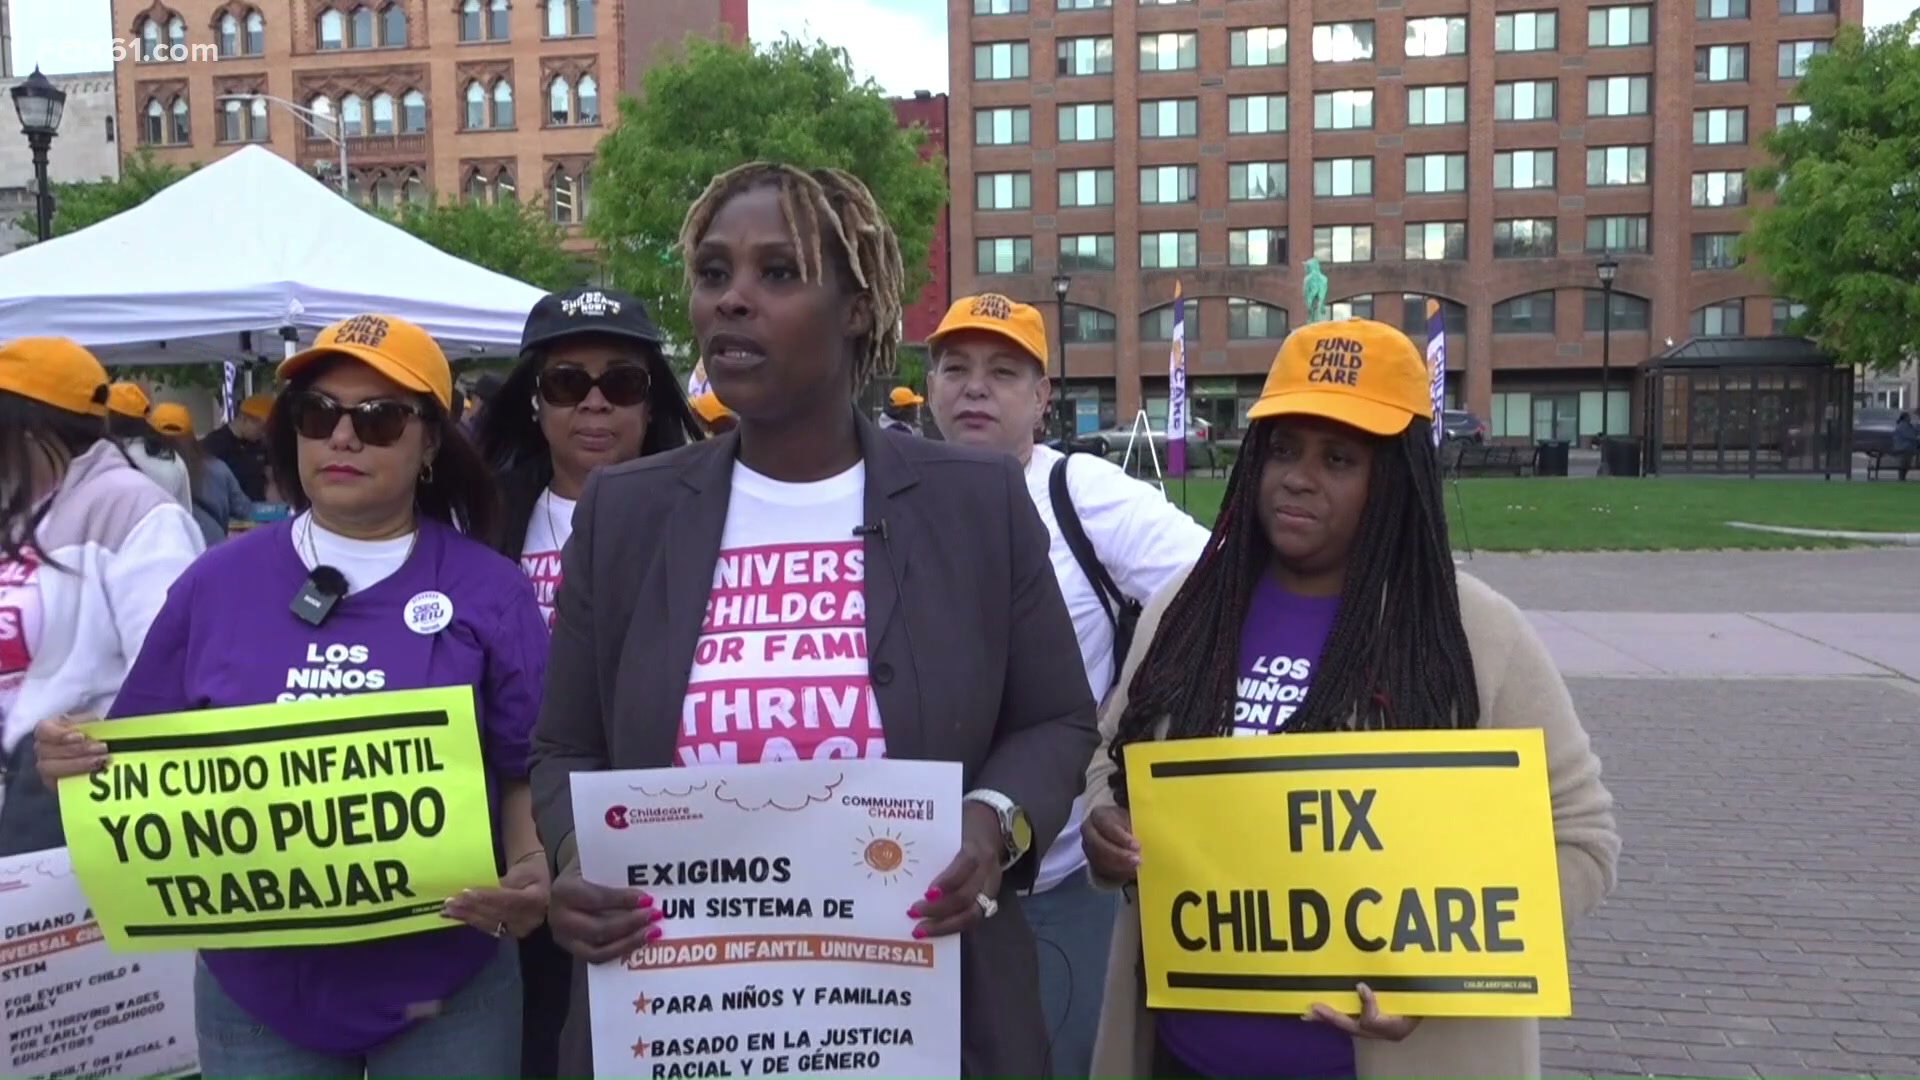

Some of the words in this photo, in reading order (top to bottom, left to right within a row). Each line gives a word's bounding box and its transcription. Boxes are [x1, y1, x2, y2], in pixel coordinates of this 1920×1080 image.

[970, 308, 1008, 320] CARE
[334, 332, 380, 348] CARE
[338, 321, 387, 338] CHILD
[1314, 337, 1363, 353] FUND
[1309, 352, 1363, 369] CHILD
[1307, 367, 1358, 387] CARE
[307, 643, 369, 664] LOS
[286, 664, 385, 689] NIÑOS
[1251, 656, 1311, 680] LOS
[89, 762, 148, 801] SIN
[159, 755, 268, 796] CUIDO
[280, 737, 444, 787] INFANTIL
[630, 807, 690, 818] Childcare
[842, 795, 924, 809] COMMUNITY
[868, 807, 925, 820] CHANGE
[99, 813, 171, 863] YO
[183, 807, 257, 858] NO
[268, 786, 445, 852] PUEDO
[1287, 788, 1383, 852] FIX
[627, 857, 791, 886] EXIGIMOS
[146, 859, 416, 918] TRABAJAR
[662, 898, 695, 919] UN
[706, 897, 812, 918] SISTEMA
[823, 899, 854, 918] DE
[1171, 889, 1331, 952] CHILD
[1344, 886, 1524, 952] CARE
[5, 912, 75, 940] DEMAND
[83, 908, 95, 920] A
[630, 943, 717, 967] CUIDADO
[724, 940, 814, 960] INFANTIL
[821, 941, 929, 964] UNIVERSAL
[5, 994, 31, 1010] FOR
[38, 978, 83, 1000] EVERY
[89, 967, 126, 987] CHILD
[651, 994, 713, 1015] PARA
[722, 984, 783, 1010] NIÑOS
[792, 988, 805, 1005] Y
[814, 987, 912, 1006] FAMILIAS
[6, 998, 56, 1020] FAMILY
[10, 1024, 43, 1042] WITH
[50, 1005, 110, 1030] THRIVING
[115, 990, 160, 1010] WAGES
[11, 1039, 37, 1054] FOR
[44, 1022, 88, 1045] EARLY
[94, 1002, 165, 1031] CHILDHOOD
[13, 1035, 94, 1068] EDUCATORS
[651, 1035, 739, 1057] BASADO
[747, 1032, 775, 1051] EN
[784, 1030, 811, 1048] LA
[820, 1028, 913, 1048] JUSTICIA
[652, 1059, 732, 1079] RACIAL
[740, 1059, 753, 1076] Y
[762, 1055, 789, 1073] DE
[797, 1047, 880, 1071] GÉNERO
